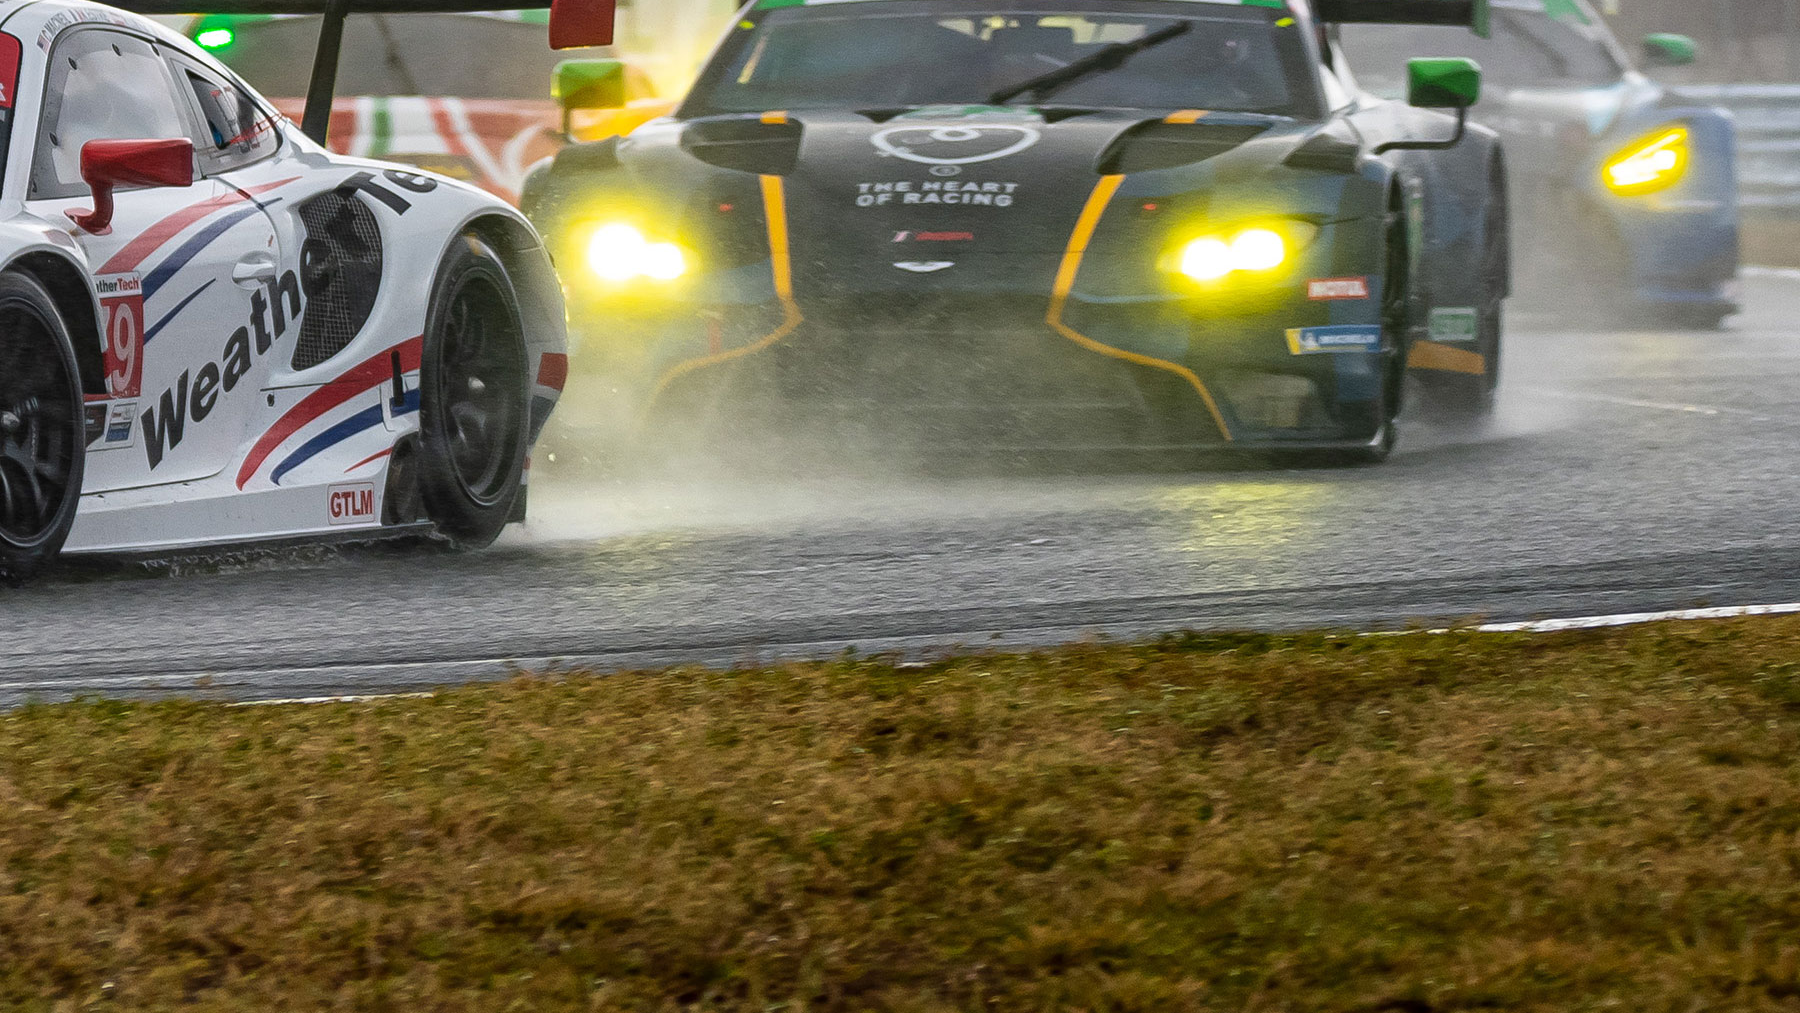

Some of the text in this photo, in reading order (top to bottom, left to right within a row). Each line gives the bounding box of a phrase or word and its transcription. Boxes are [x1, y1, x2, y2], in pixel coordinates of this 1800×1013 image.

[856, 181, 1019, 194] THE HEART
[856, 193, 1013, 208] OF RACING
[96, 277, 140, 294] therTech
[330, 493, 374, 518] GTLM
